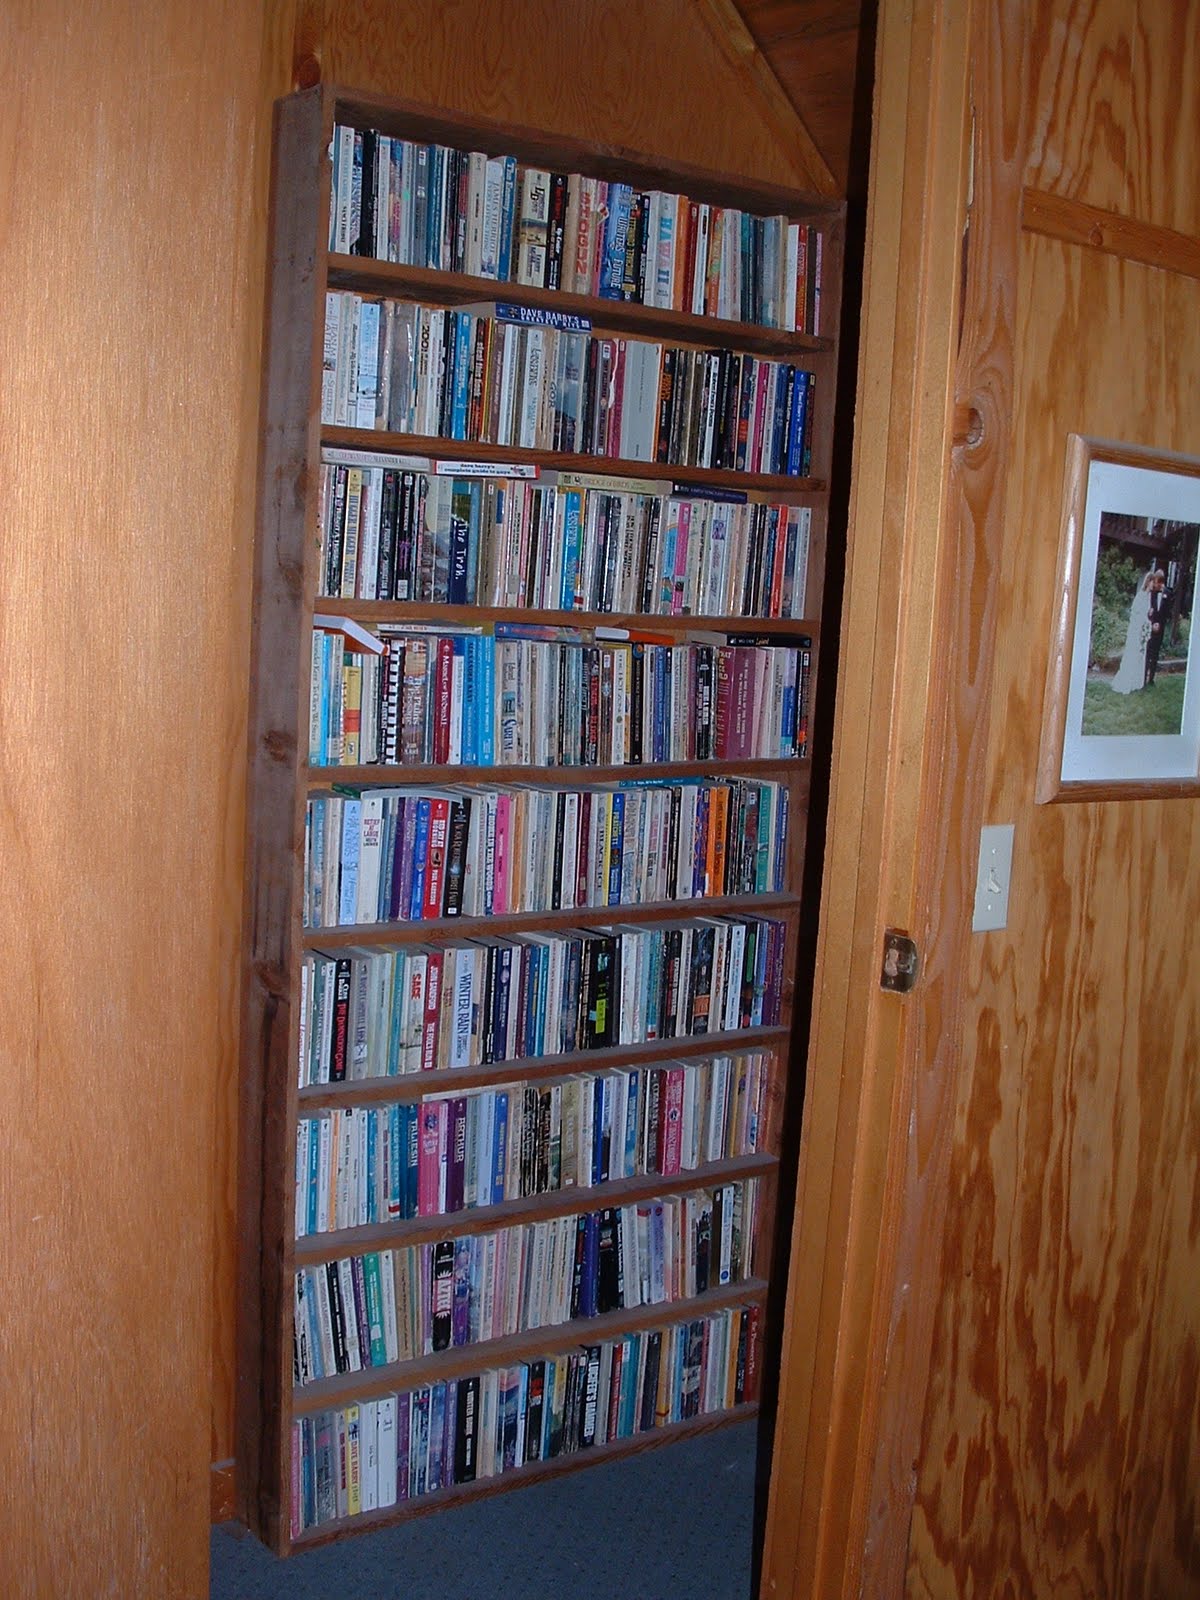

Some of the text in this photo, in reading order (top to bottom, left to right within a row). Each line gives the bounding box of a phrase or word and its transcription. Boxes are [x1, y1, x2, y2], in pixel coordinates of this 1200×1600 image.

[658, 217, 673, 286] HAWAII
[520, 308, 544, 320] DAVE
[548, 382, 557, 409] GOR
[349, 496, 359, 524] HUGGER
[456, 521, 468, 543] The
[413, 697, 422, 726] Plains
[501, 719, 517, 751] SARUM
[457, 973, 472, 1035] WINTER RAIN
[336, 1016, 345, 1052] DAMNATION
[410, 1118, 418, 1167] TALIESIN
[456, 1117, 466, 1163] ARTHUR
[584, 1361, 600, 1438] LUCIFER'S HAMMER
